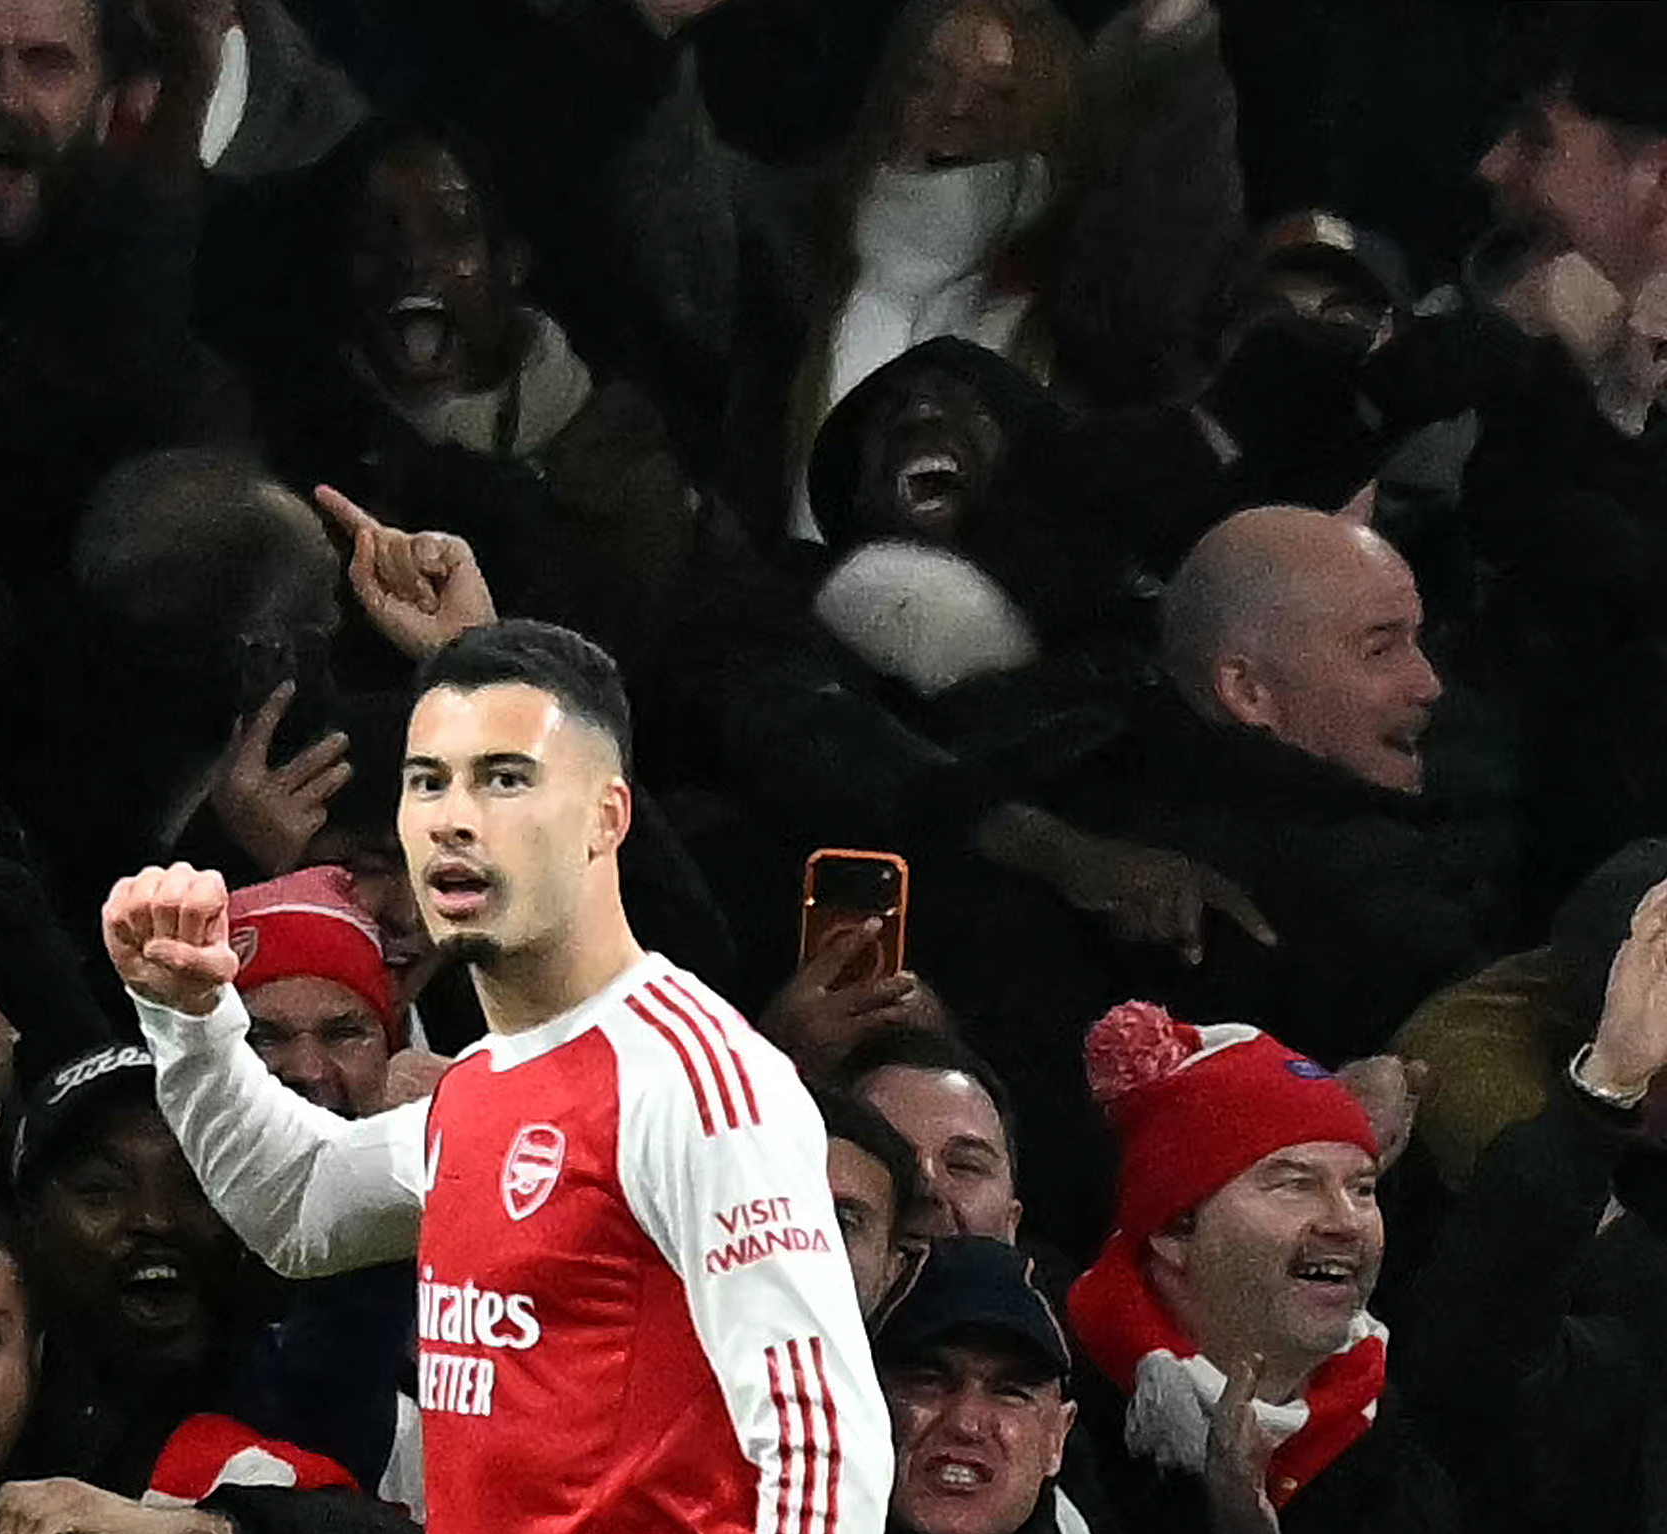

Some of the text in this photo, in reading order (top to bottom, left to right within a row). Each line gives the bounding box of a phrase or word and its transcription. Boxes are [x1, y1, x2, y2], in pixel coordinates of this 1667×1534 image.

[46, 1046, 152, 1105] Title
[714, 1196, 792, 1235] VISIT
[418, 1262, 540, 1350] irates
